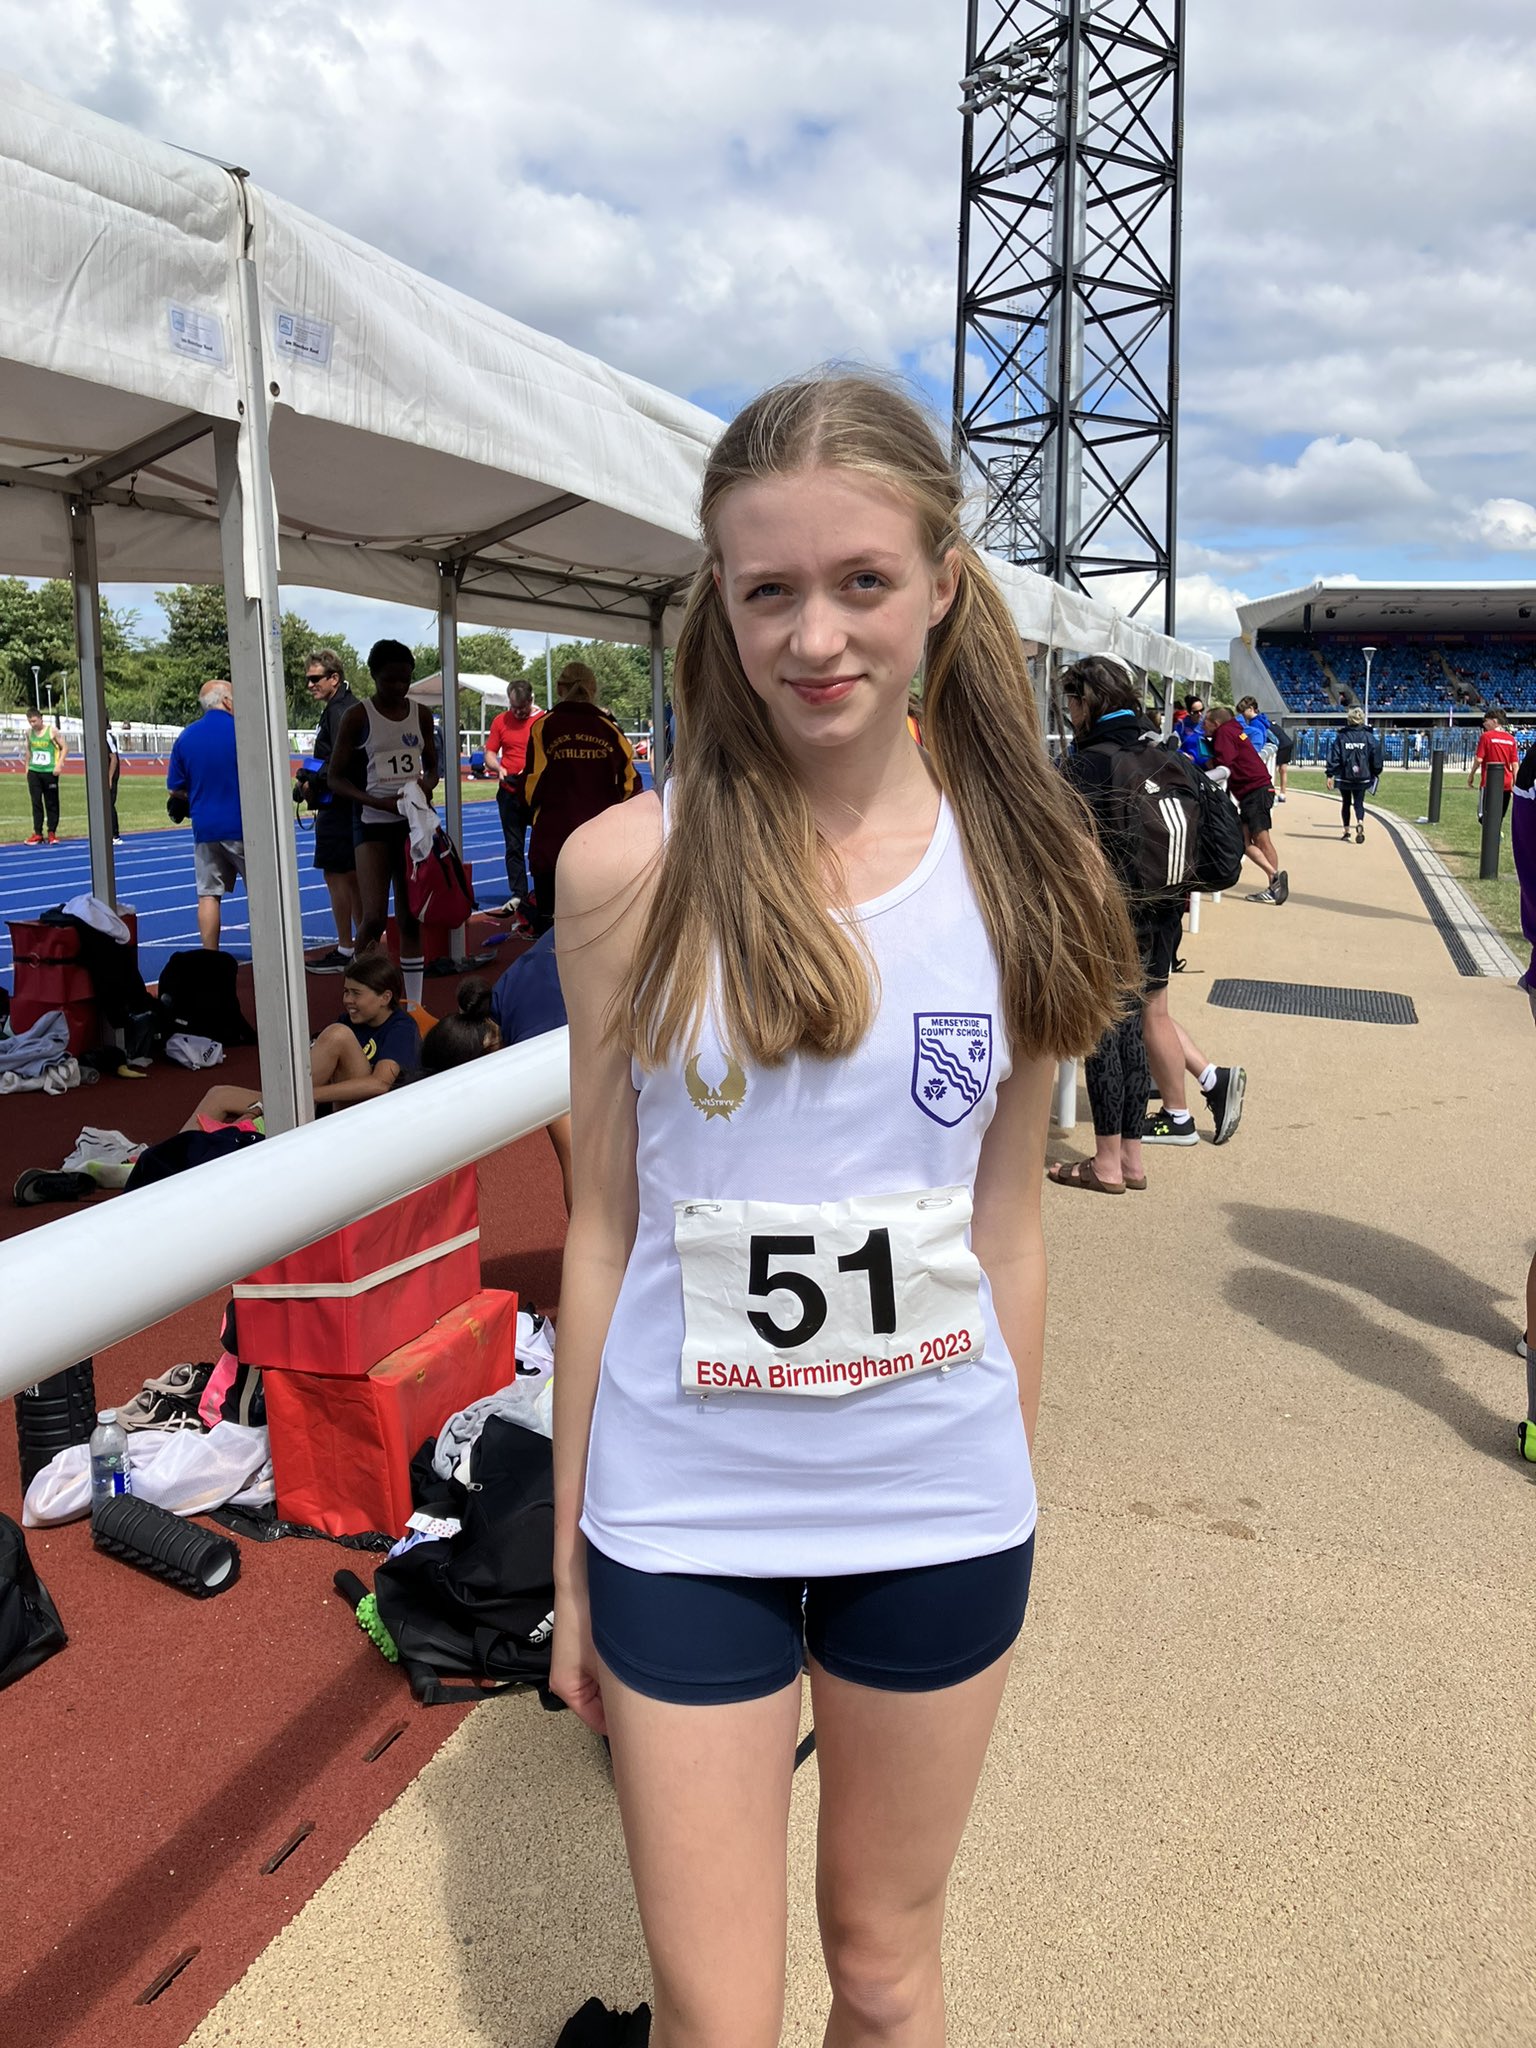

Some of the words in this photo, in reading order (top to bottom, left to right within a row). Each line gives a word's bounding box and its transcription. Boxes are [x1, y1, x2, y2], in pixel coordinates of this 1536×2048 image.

[546, 734, 571, 755] ESSEX
[575, 733, 614, 753] SCHOOLS
[553, 748, 608, 760] ATHLETICS
[387, 754, 414, 774] 13
[920, 1027, 954, 1037] COUNTY
[956, 1028, 988, 1038] SCHOOLS
[931, 1018, 980, 1028] MERSEYSIDE
[746, 1227, 897, 1349] 51
[697, 1360, 762, 1388] ESAA
[768, 1353, 914, 1389] Birmingham
[919, 1329, 972, 1366] 2023
